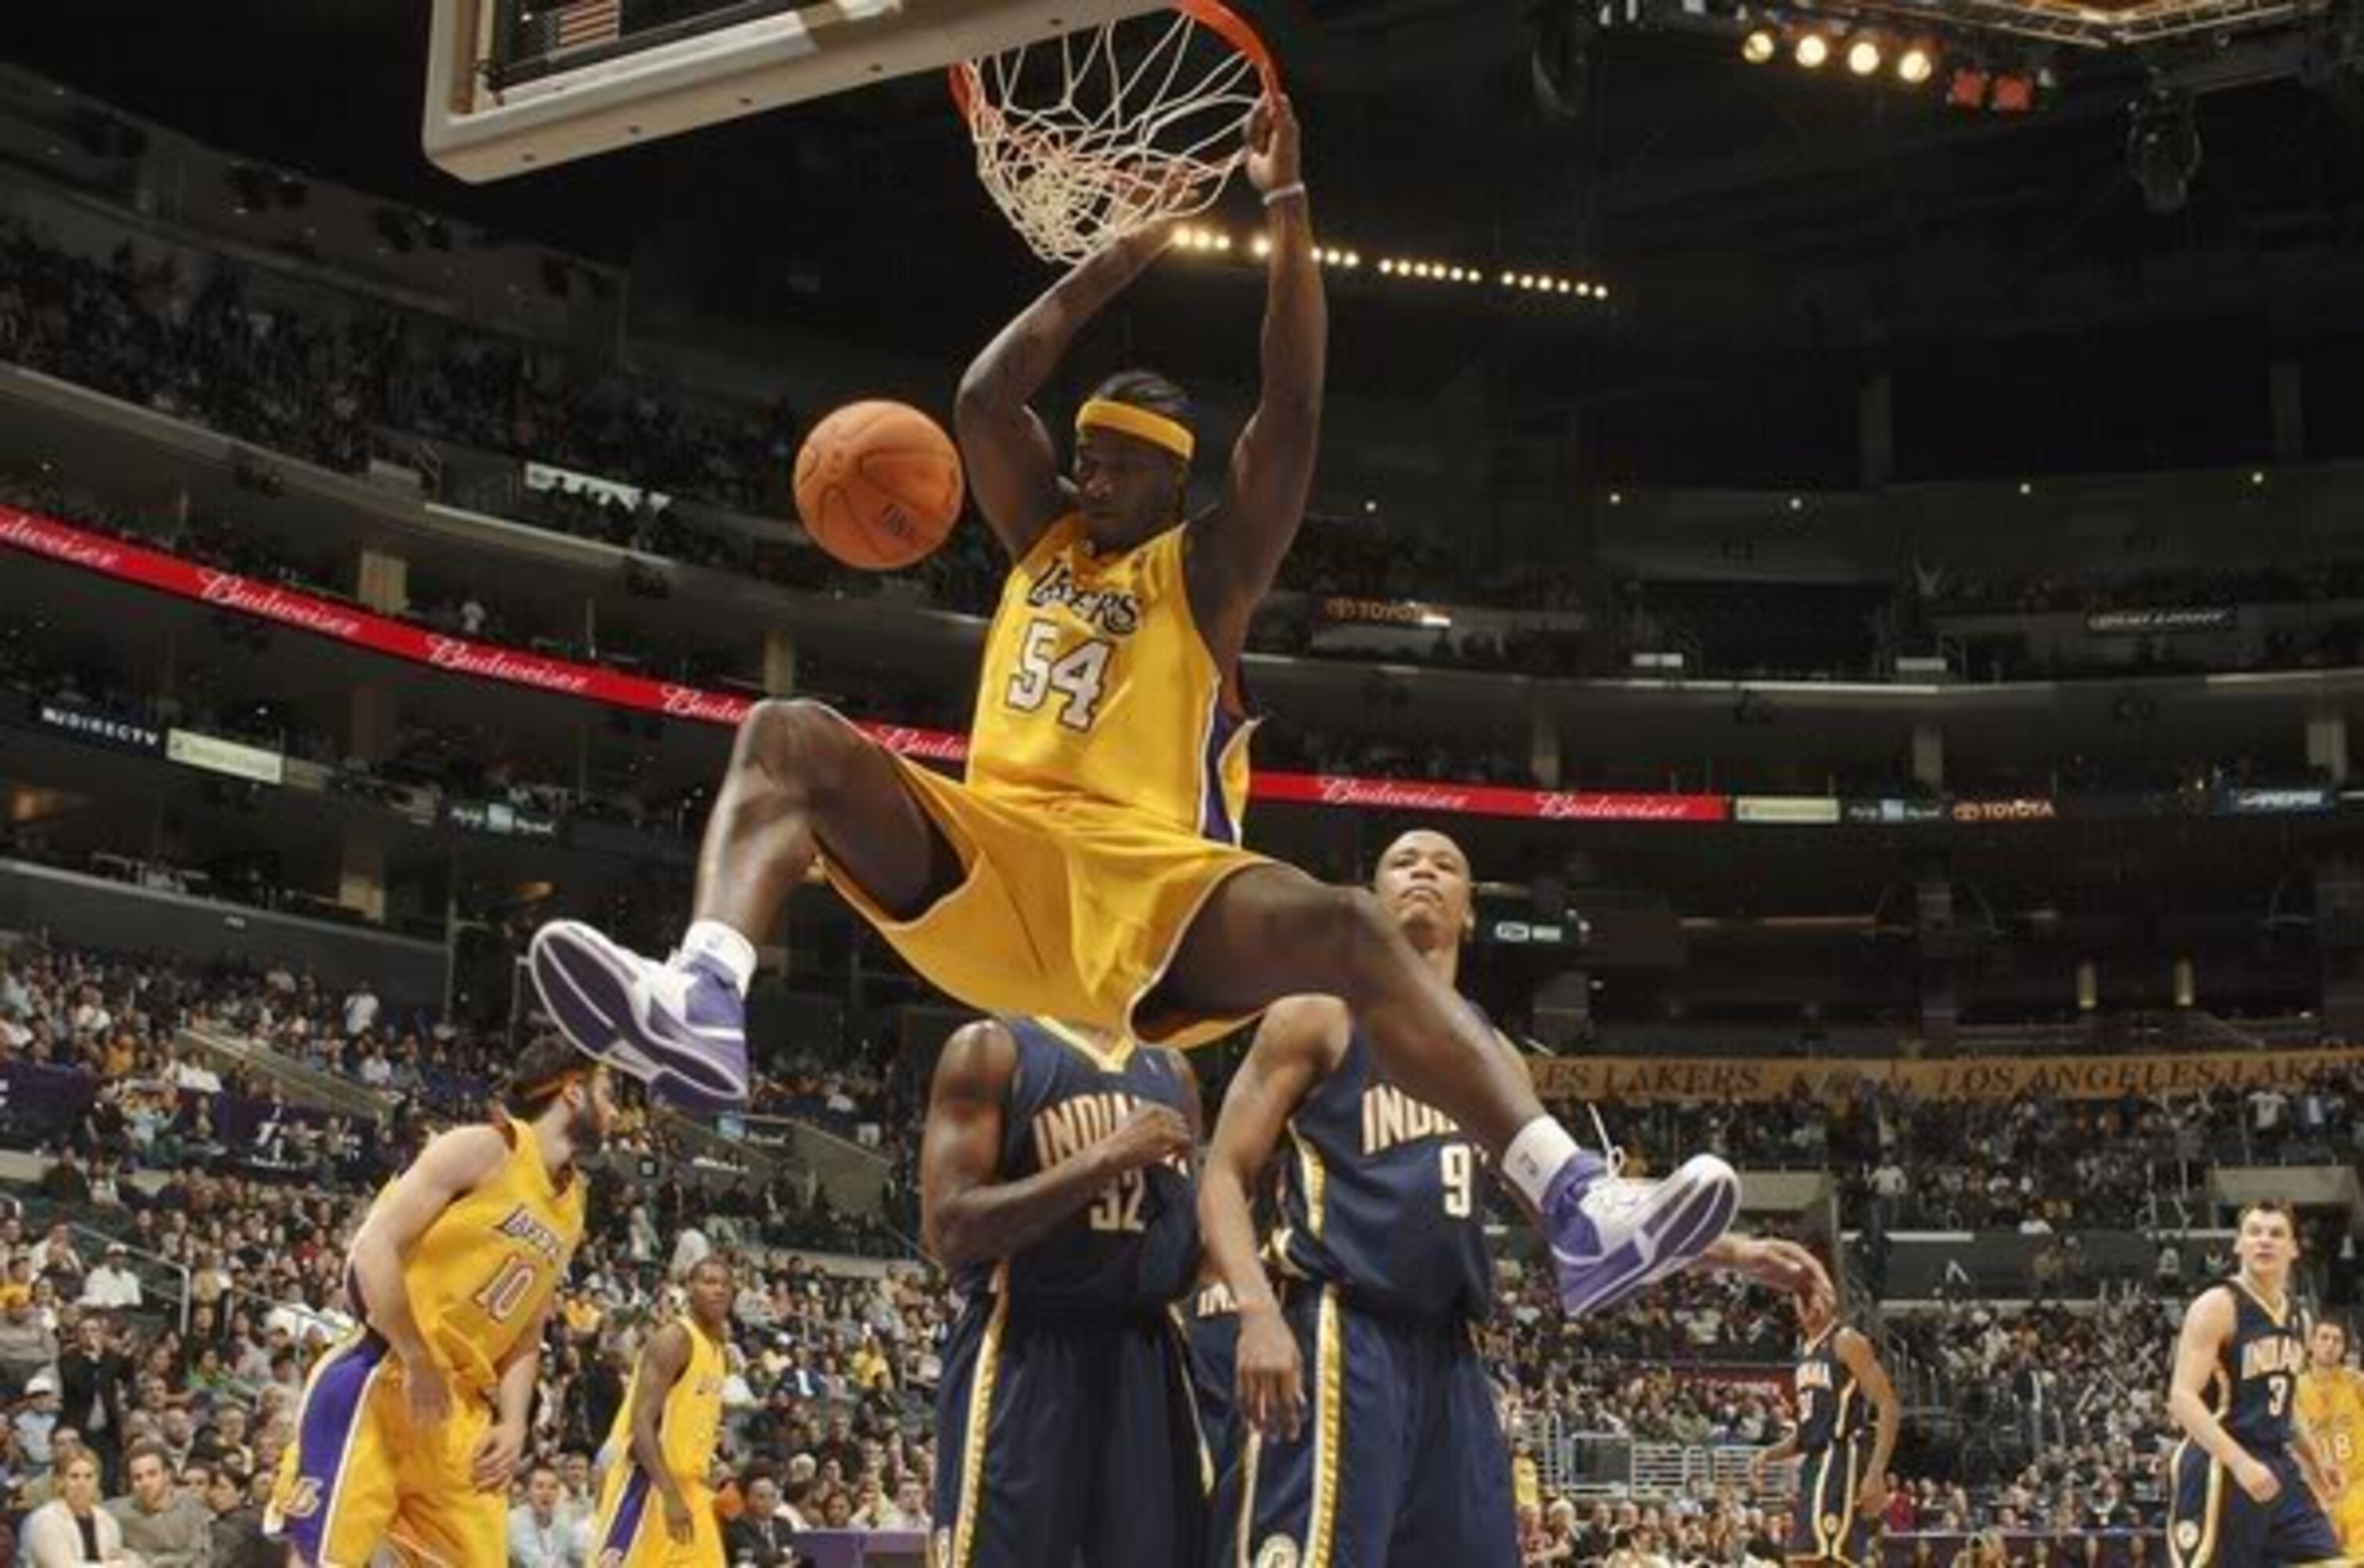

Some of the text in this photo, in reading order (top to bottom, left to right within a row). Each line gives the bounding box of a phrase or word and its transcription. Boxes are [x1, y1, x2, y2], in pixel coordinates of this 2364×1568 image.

[197, 568, 361, 635] Budweiser
[425, 633, 588, 692] Budweiser
[1005, 618, 1115, 732] 54
[67, 711, 158, 745] DIRECTV
[1319, 775, 1469, 810] Budweiser
[1535, 792, 1689, 819] Budweiser
[1982, 801, 2054, 820] TOYOTA
[1604, 1062, 1762, 1095] LAKERS
[1937, 1065, 2014, 1094] LOS
[2026, 1059, 2217, 1092] ANGELES
[1441, 1143, 1472, 1218] 9
[471, 1252, 536, 1323] 10
[2268, 1374, 2288, 1417] 3
